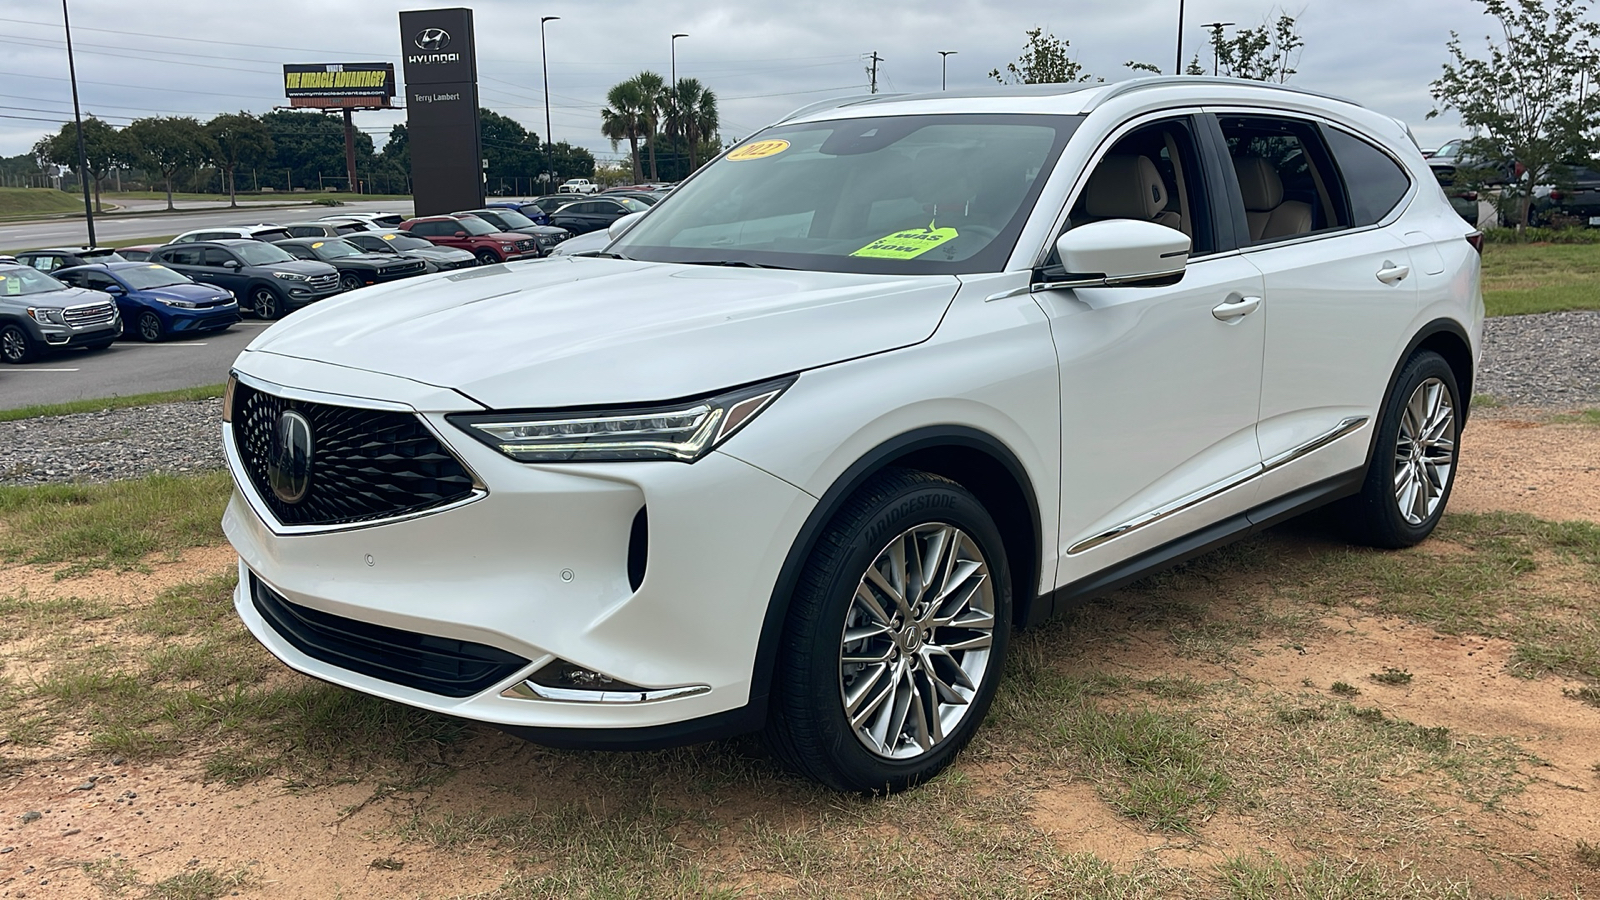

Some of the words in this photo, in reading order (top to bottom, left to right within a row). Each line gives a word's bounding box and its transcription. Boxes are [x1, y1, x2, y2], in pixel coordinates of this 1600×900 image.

[408, 53, 460, 63] HYUNDAI
[286, 73, 300, 88] THE
[300, 71, 335, 88] MIRACLE
[334, 71, 386, 87] ADVANTAGE?
[414, 93, 433, 104] Terry
[433, 92, 460, 102] Lambert
[731, 143, 784, 158] 2022
[894, 233, 943, 241] WAS
[863, 493, 959, 547] BRIDGESTONE
